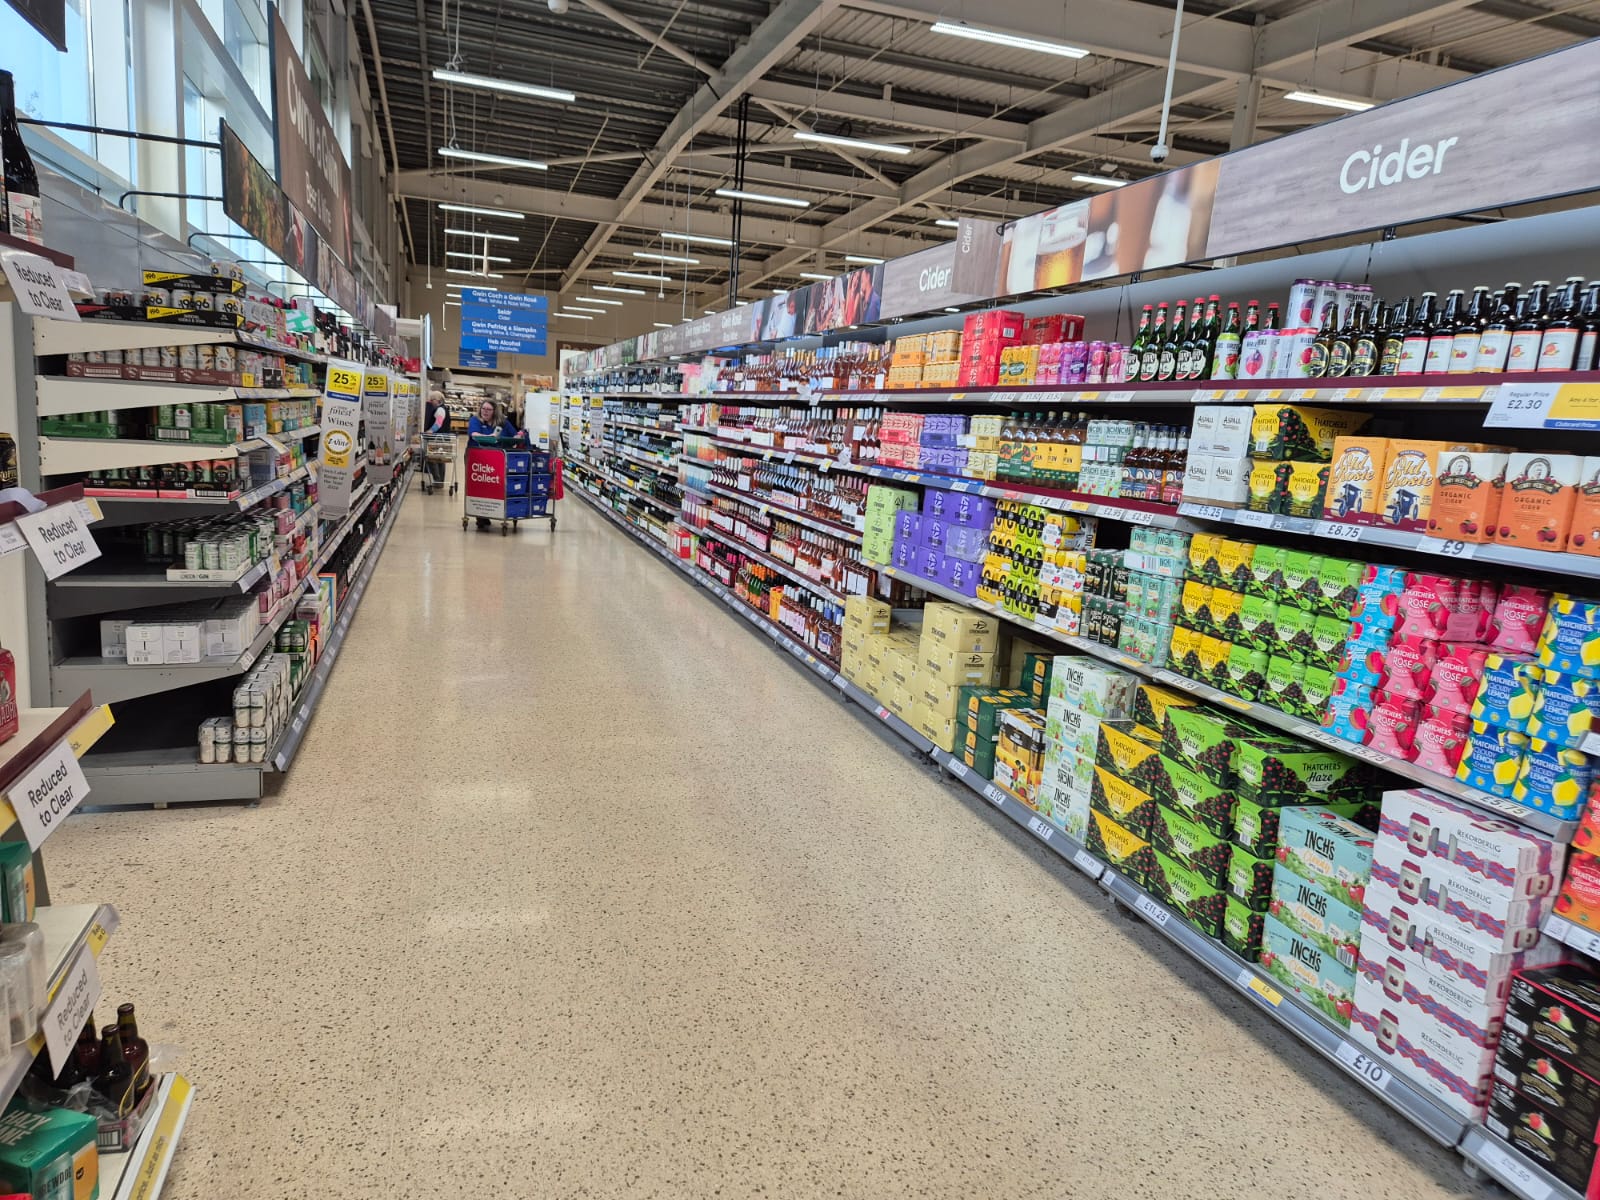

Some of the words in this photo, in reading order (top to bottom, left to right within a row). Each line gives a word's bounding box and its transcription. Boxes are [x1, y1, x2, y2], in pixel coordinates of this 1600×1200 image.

[1339, 136, 1459, 194] Cider
[961, 224, 974, 253] Cider
[13, 261, 57, 288] Reduced
[919, 267, 951, 292] Cider
[28, 291, 39, 307] to
[37, 291, 65, 312] Clear
[472, 290, 486, 298] Gwin
[333, 372, 349, 384] 25
[367, 377, 379, 386] 25
[1507, 400, 1542, 410] £2.30
[327, 418, 354, 428] Wines
[1223, 416, 1242, 424] ASPALL
[1319, 428, 1340, 439] Gold
[471, 473, 500, 484] Collect
[1216, 466, 1233, 476] ASPALL
[1440, 491, 1472, 500] ORGANIC
[1514, 496, 1552, 505] ORGANIC
[1103, 508, 1122, 517] £2.95
[1131, 512, 1152, 522] £2.95
[1198, 506, 1220, 518] £5.25
[38, 516, 78, 544] Reduced
[1328, 524, 1360, 538] £8.75
[54, 549, 67, 564] to
[64, 540, 87, 559] Clear
[1440, 540, 1465, 556] £9
[1323, 581, 1342, 590] Haze
[1405, 588, 1436, 600] THATCHERS
[1501, 600, 1535, 612] THATCHERS
[1555, 618, 1594, 632] THATCHERS
[1558, 635, 1584, 646] LEMON
[1390, 646, 1420, 661] THATCHERS
[1436, 659, 1468, 674] THATCHERS
[1066, 667, 1084, 687] INCH'S
[1486, 673, 1520, 688] THATCHERS
[1307, 688, 1324, 699] Haze
[1488, 688, 1510, 701] LEMON
[1542, 687, 1580, 703] THATCHERS
[1063, 708, 1082, 728] INCH'S
[1374, 704, 1403, 720] THATCHERS
[1544, 704, 1570, 716] LEMON
[1179, 723, 1206, 743] THATCHERS
[1304, 728, 1338, 744] £4.75
[1420, 721, 1452, 737] THATCHERS
[1182, 733, 1200, 752] Haze
[1470, 736, 1504, 753] THATCHERS
[1350, 744, 1386, 762] £5.75
[1472, 752, 1496, 766] LEMON
[1302, 760, 1342, 772] THATCHERS
[1528, 754, 1564, 772] THATCHERS
[27, 760, 68, 808] Reduced
[1175, 772, 1203, 794] THATCHERS
[1307, 772, 1334, 785] Haze
[1530, 772, 1554, 784] LEMON
[990, 787, 1004, 804] £10
[1054, 788, 1071, 808] INCH'S
[1178, 783, 1198, 802] Haze
[39, 811, 52, 828] to
[50, 785, 74, 815] Clear
[1480, 794, 1526, 817] £5.75
[1036, 820, 1050, 836] £11
[1172, 820, 1200, 842] THATCHERS
[1174, 831, 1194, 851] Haze
[1304, 829, 1336, 861] INCH'S
[1456, 828, 1502, 854] REKORDERLIG
[1168, 866, 1197, 891] THATCHERS
[1171, 880, 1191, 898] Haze
[1447, 878, 1492, 905] REKORDERLIG
[1298, 884, 1328, 918] INCH'S
[1142, 900, 1168, 922] £11.25
[1432, 926, 1475, 955] REKORDERLIG
[1290, 938, 1322, 972] INCH'S
[57, 968, 88, 1030] Reduced
[1428, 977, 1474, 1008] REKORDERLIG
[63, 1027, 73, 1046] to
[72, 993, 92, 1028] Clear
[1420, 1031, 1464, 1066] REKORDERLIG
[1352, 1054, 1383, 1082] £10
